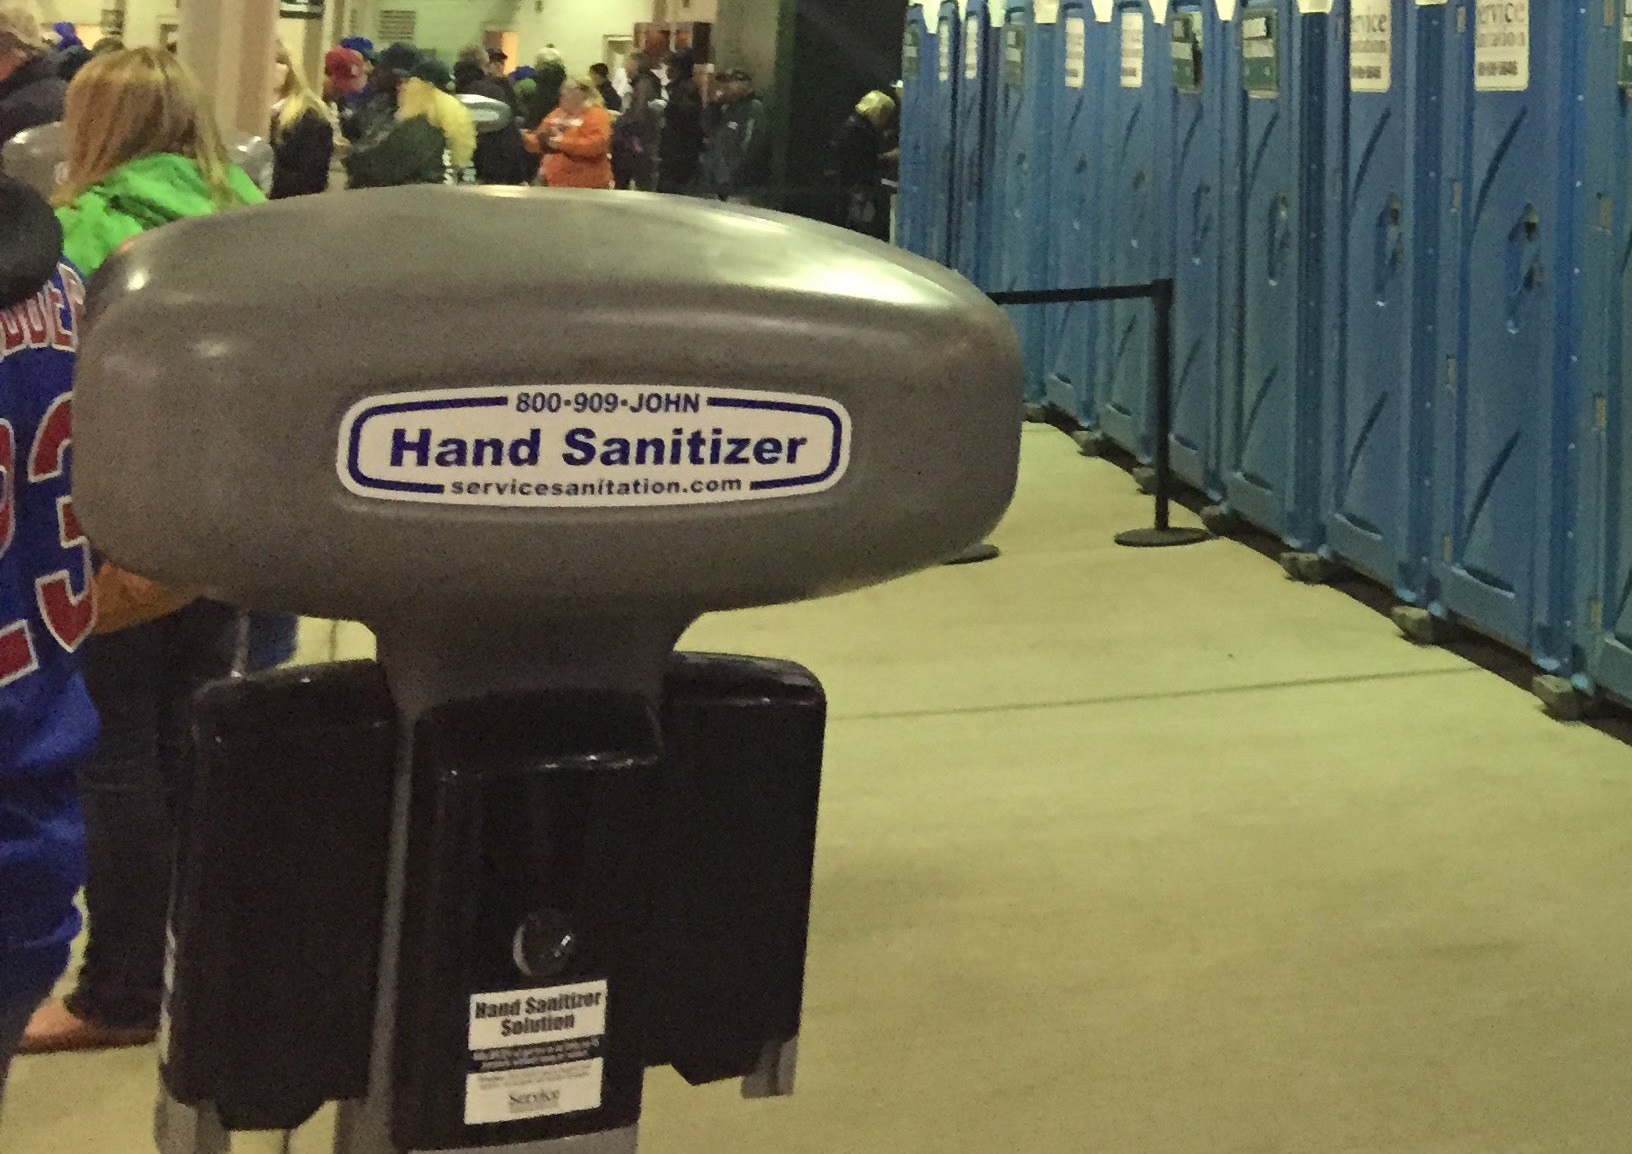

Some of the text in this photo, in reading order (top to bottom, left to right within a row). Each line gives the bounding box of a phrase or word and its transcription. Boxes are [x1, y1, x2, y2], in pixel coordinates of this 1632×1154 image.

[389, 427, 808, 467] Hand Sanitizer
[450, 477, 743, 497] servicesanitation.com
[475, 991, 602, 1019] Hand Sanitizer
